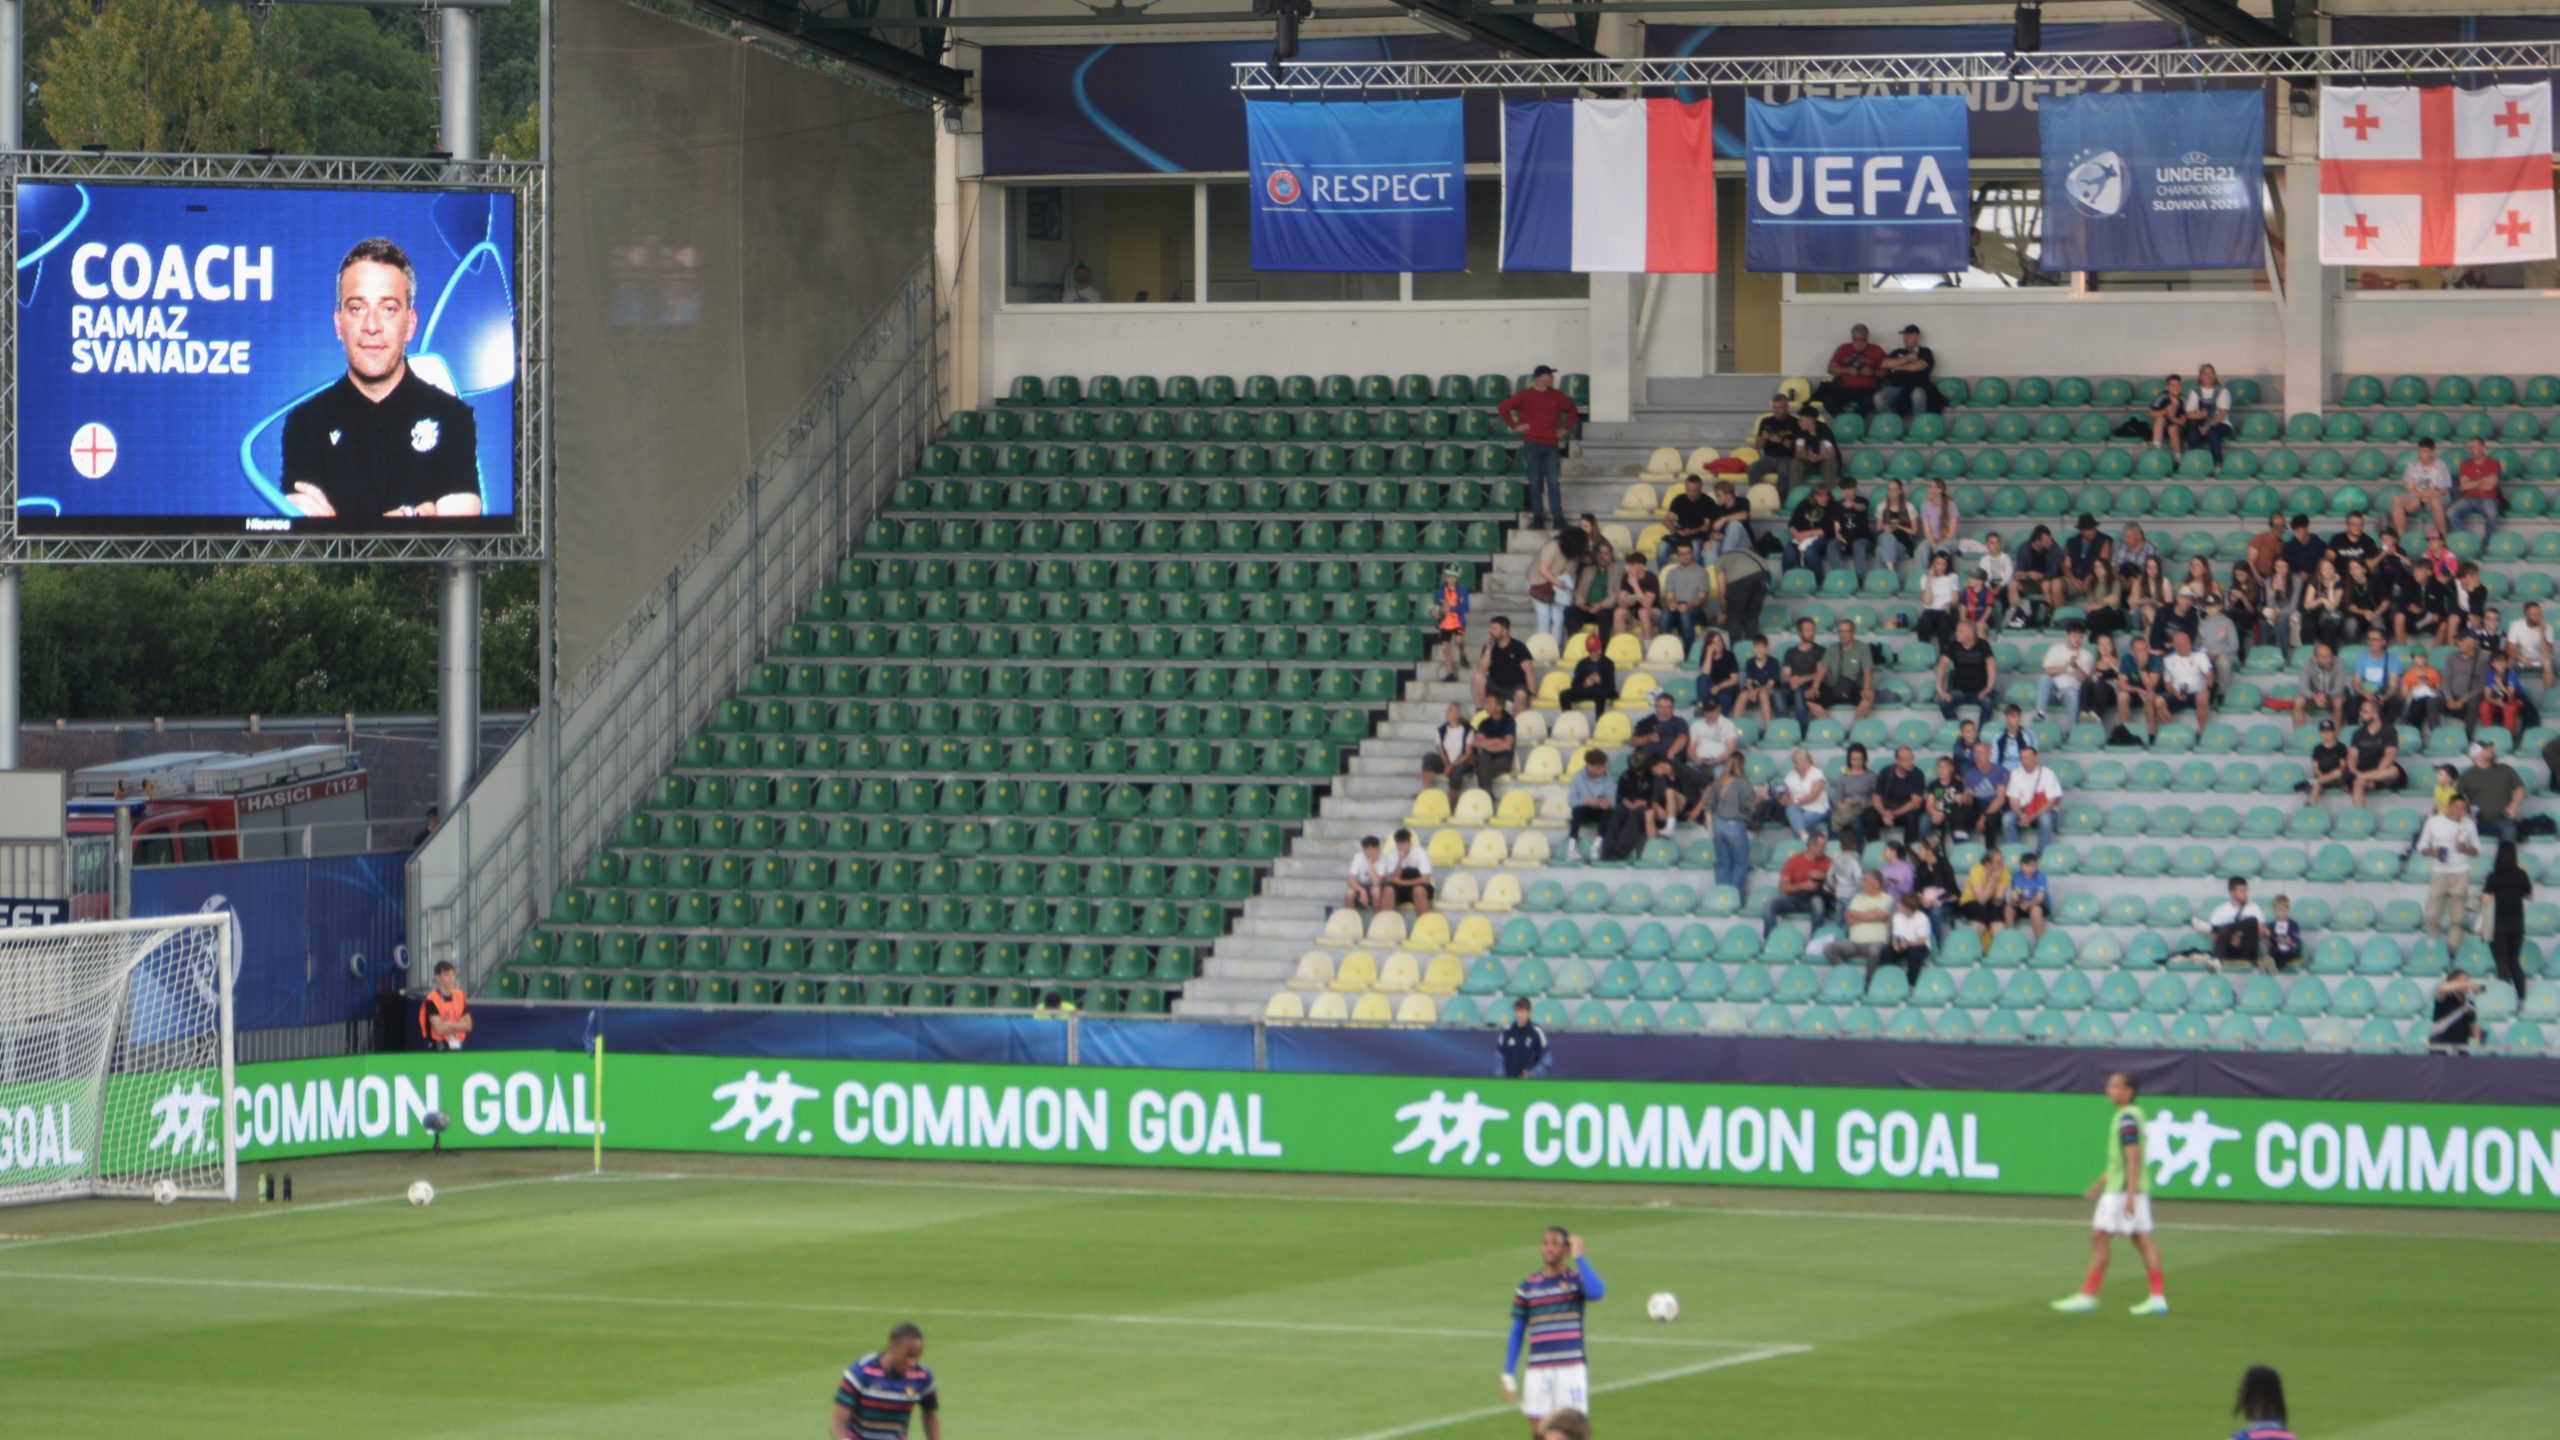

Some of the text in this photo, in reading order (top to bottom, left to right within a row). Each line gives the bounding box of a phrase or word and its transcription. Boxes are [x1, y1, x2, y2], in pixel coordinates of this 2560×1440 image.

[1312, 172, 1453, 203] RESPECT
[1756, 154, 1957, 216] UEFA
[2156, 167, 2236, 183] UNDER21
[2156, 184, 2237, 196] CHAMPIONSHIP
[2152, 199, 2241, 211] SLOVAKIA 2025
[71, 242, 273, 301] COACH
[71, 306, 188, 340] RAMAZ
[71, 340, 251, 375] SVANADZE
[233, 1071, 606, 1149] COMMON GOAL
[833, 1080, 1282, 1157] COMMON GOAL
[1522, 1101, 1999, 1179] COMMON GOAL
[2255, 1120, 2560, 1196] COMMON
